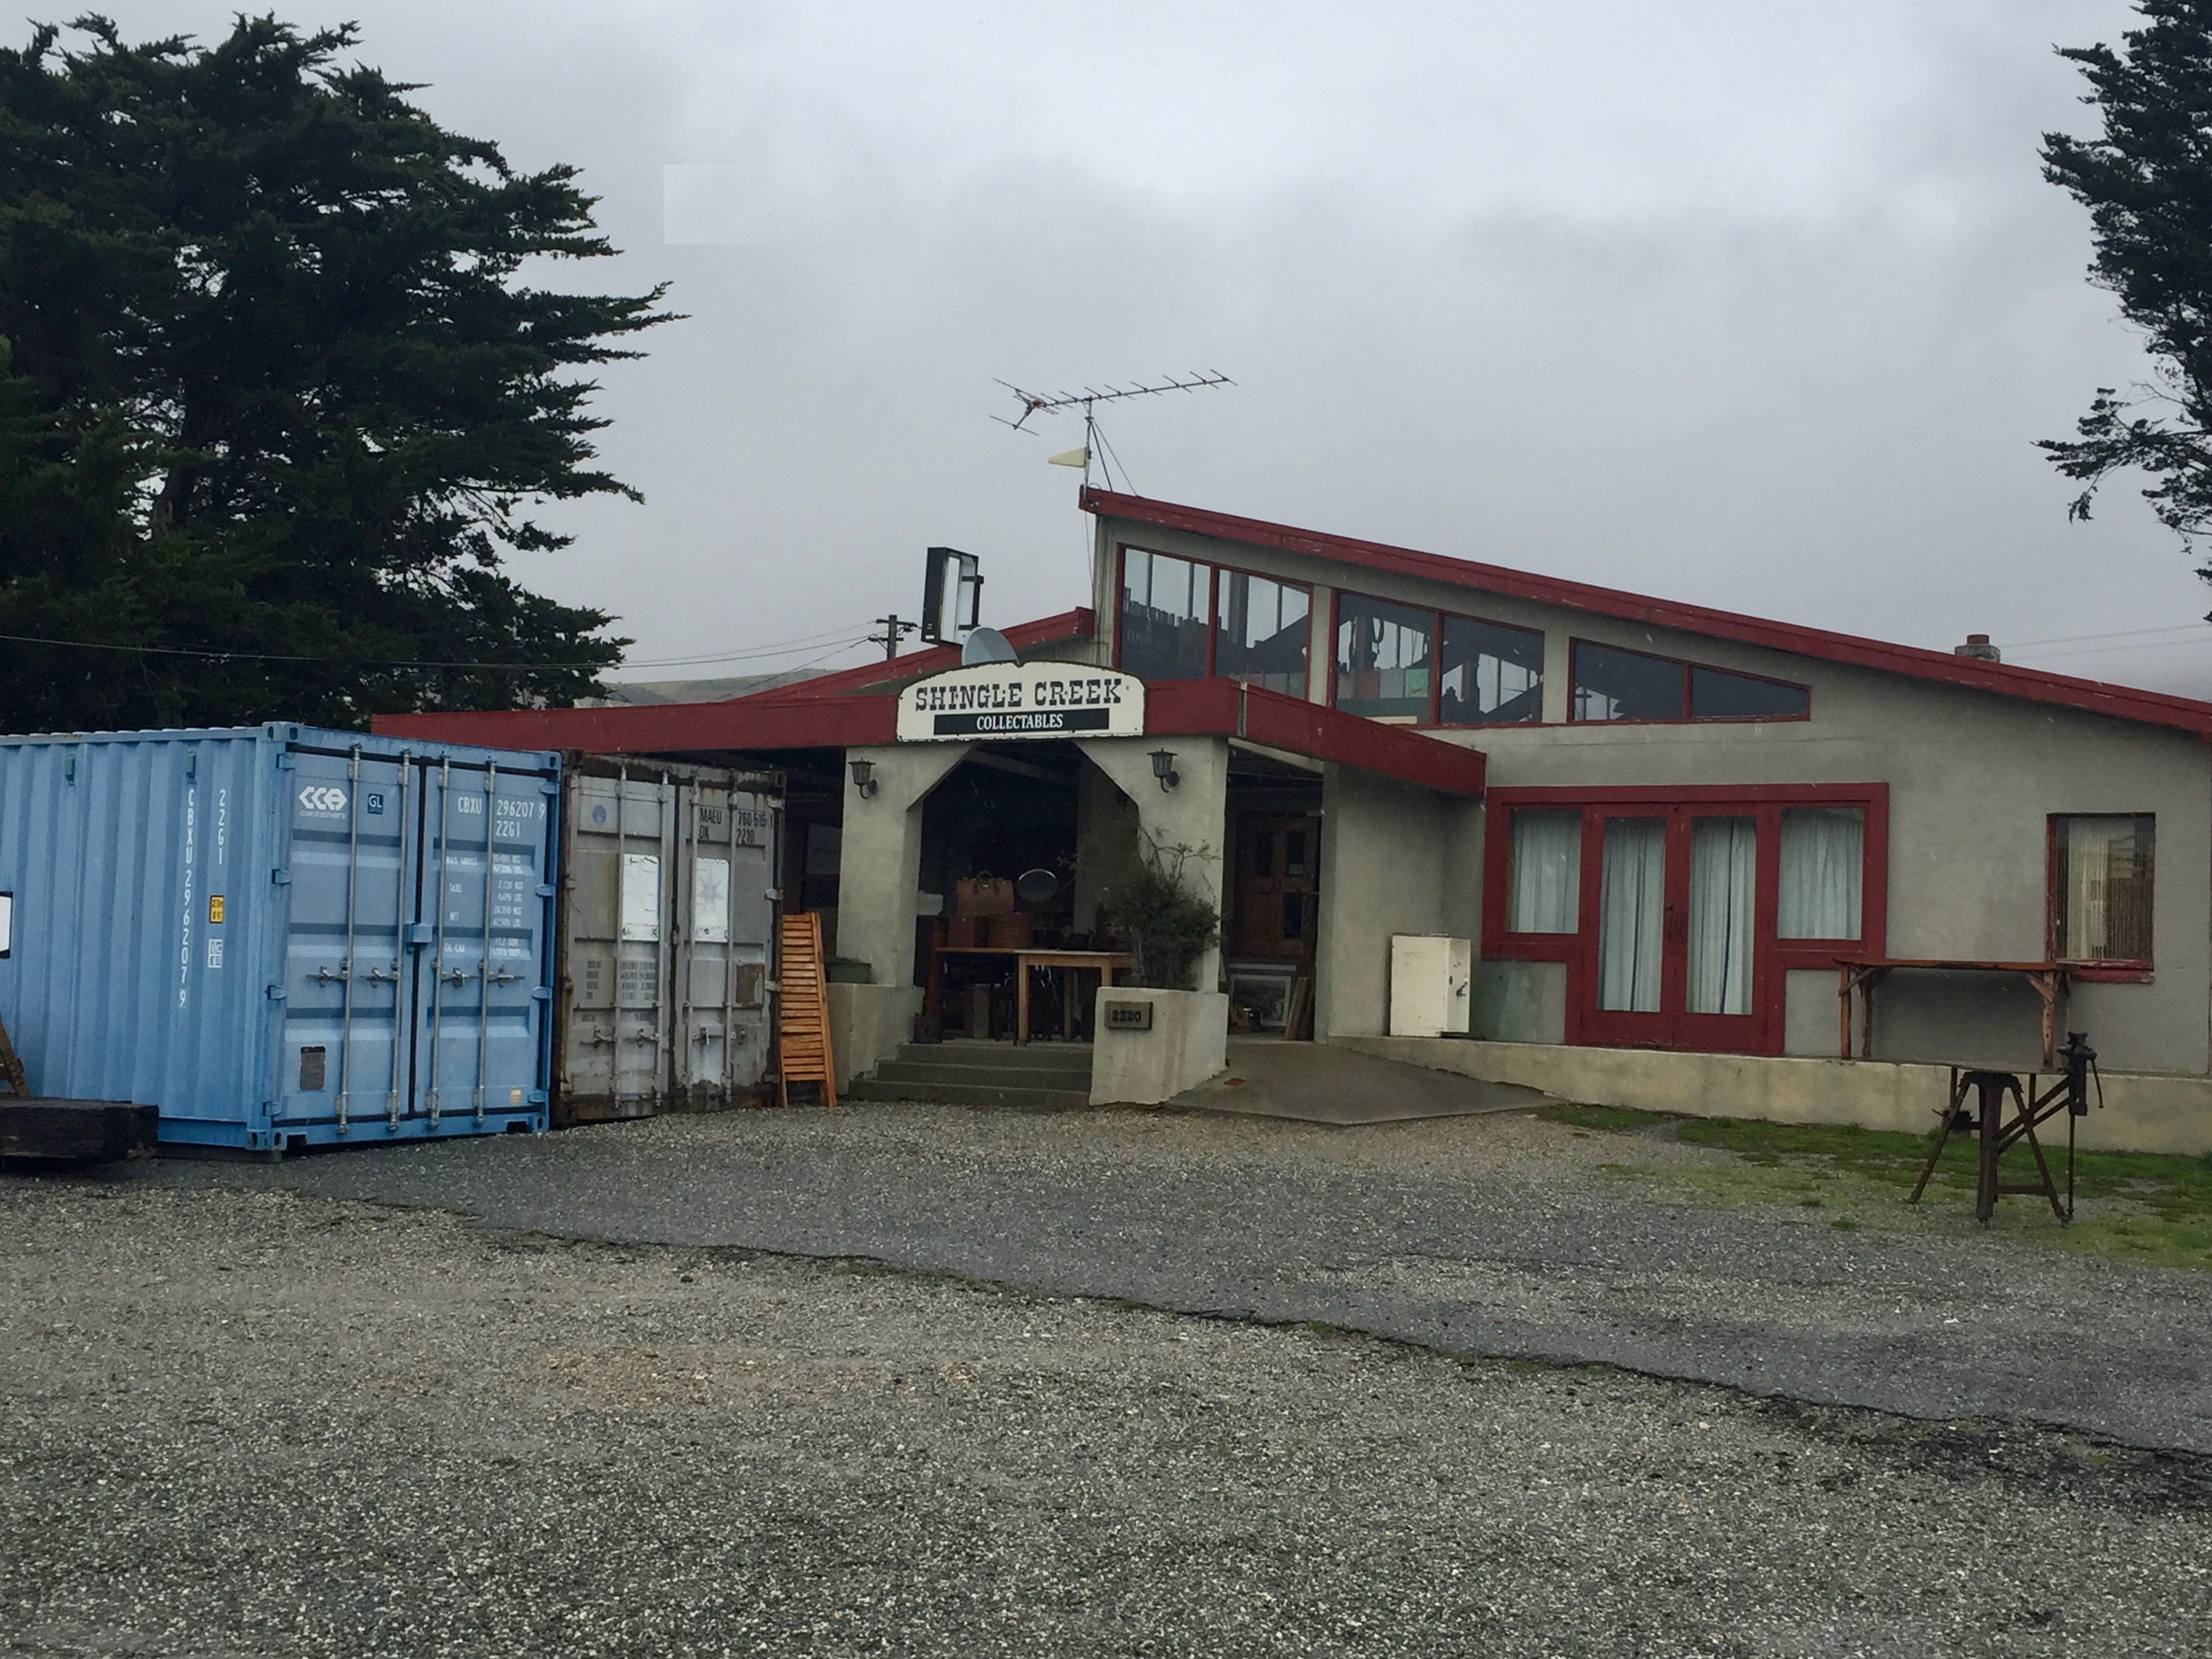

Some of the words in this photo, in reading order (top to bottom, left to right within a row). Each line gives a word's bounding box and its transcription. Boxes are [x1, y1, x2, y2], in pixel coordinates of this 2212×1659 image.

[916, 682, 1022, 711] SHINGLE
[1035, 678, 1122, 707] CREEK
[977, 713, 1064, 731] COLLECTABLES
[369, 795, 383, 808] GL
[458, 796, 483, 814] CBXU
[496, 799, 535, 818] 296207
[700, 807, 722, 825] MAEU
[496, 821, 520, 838] 22G1
